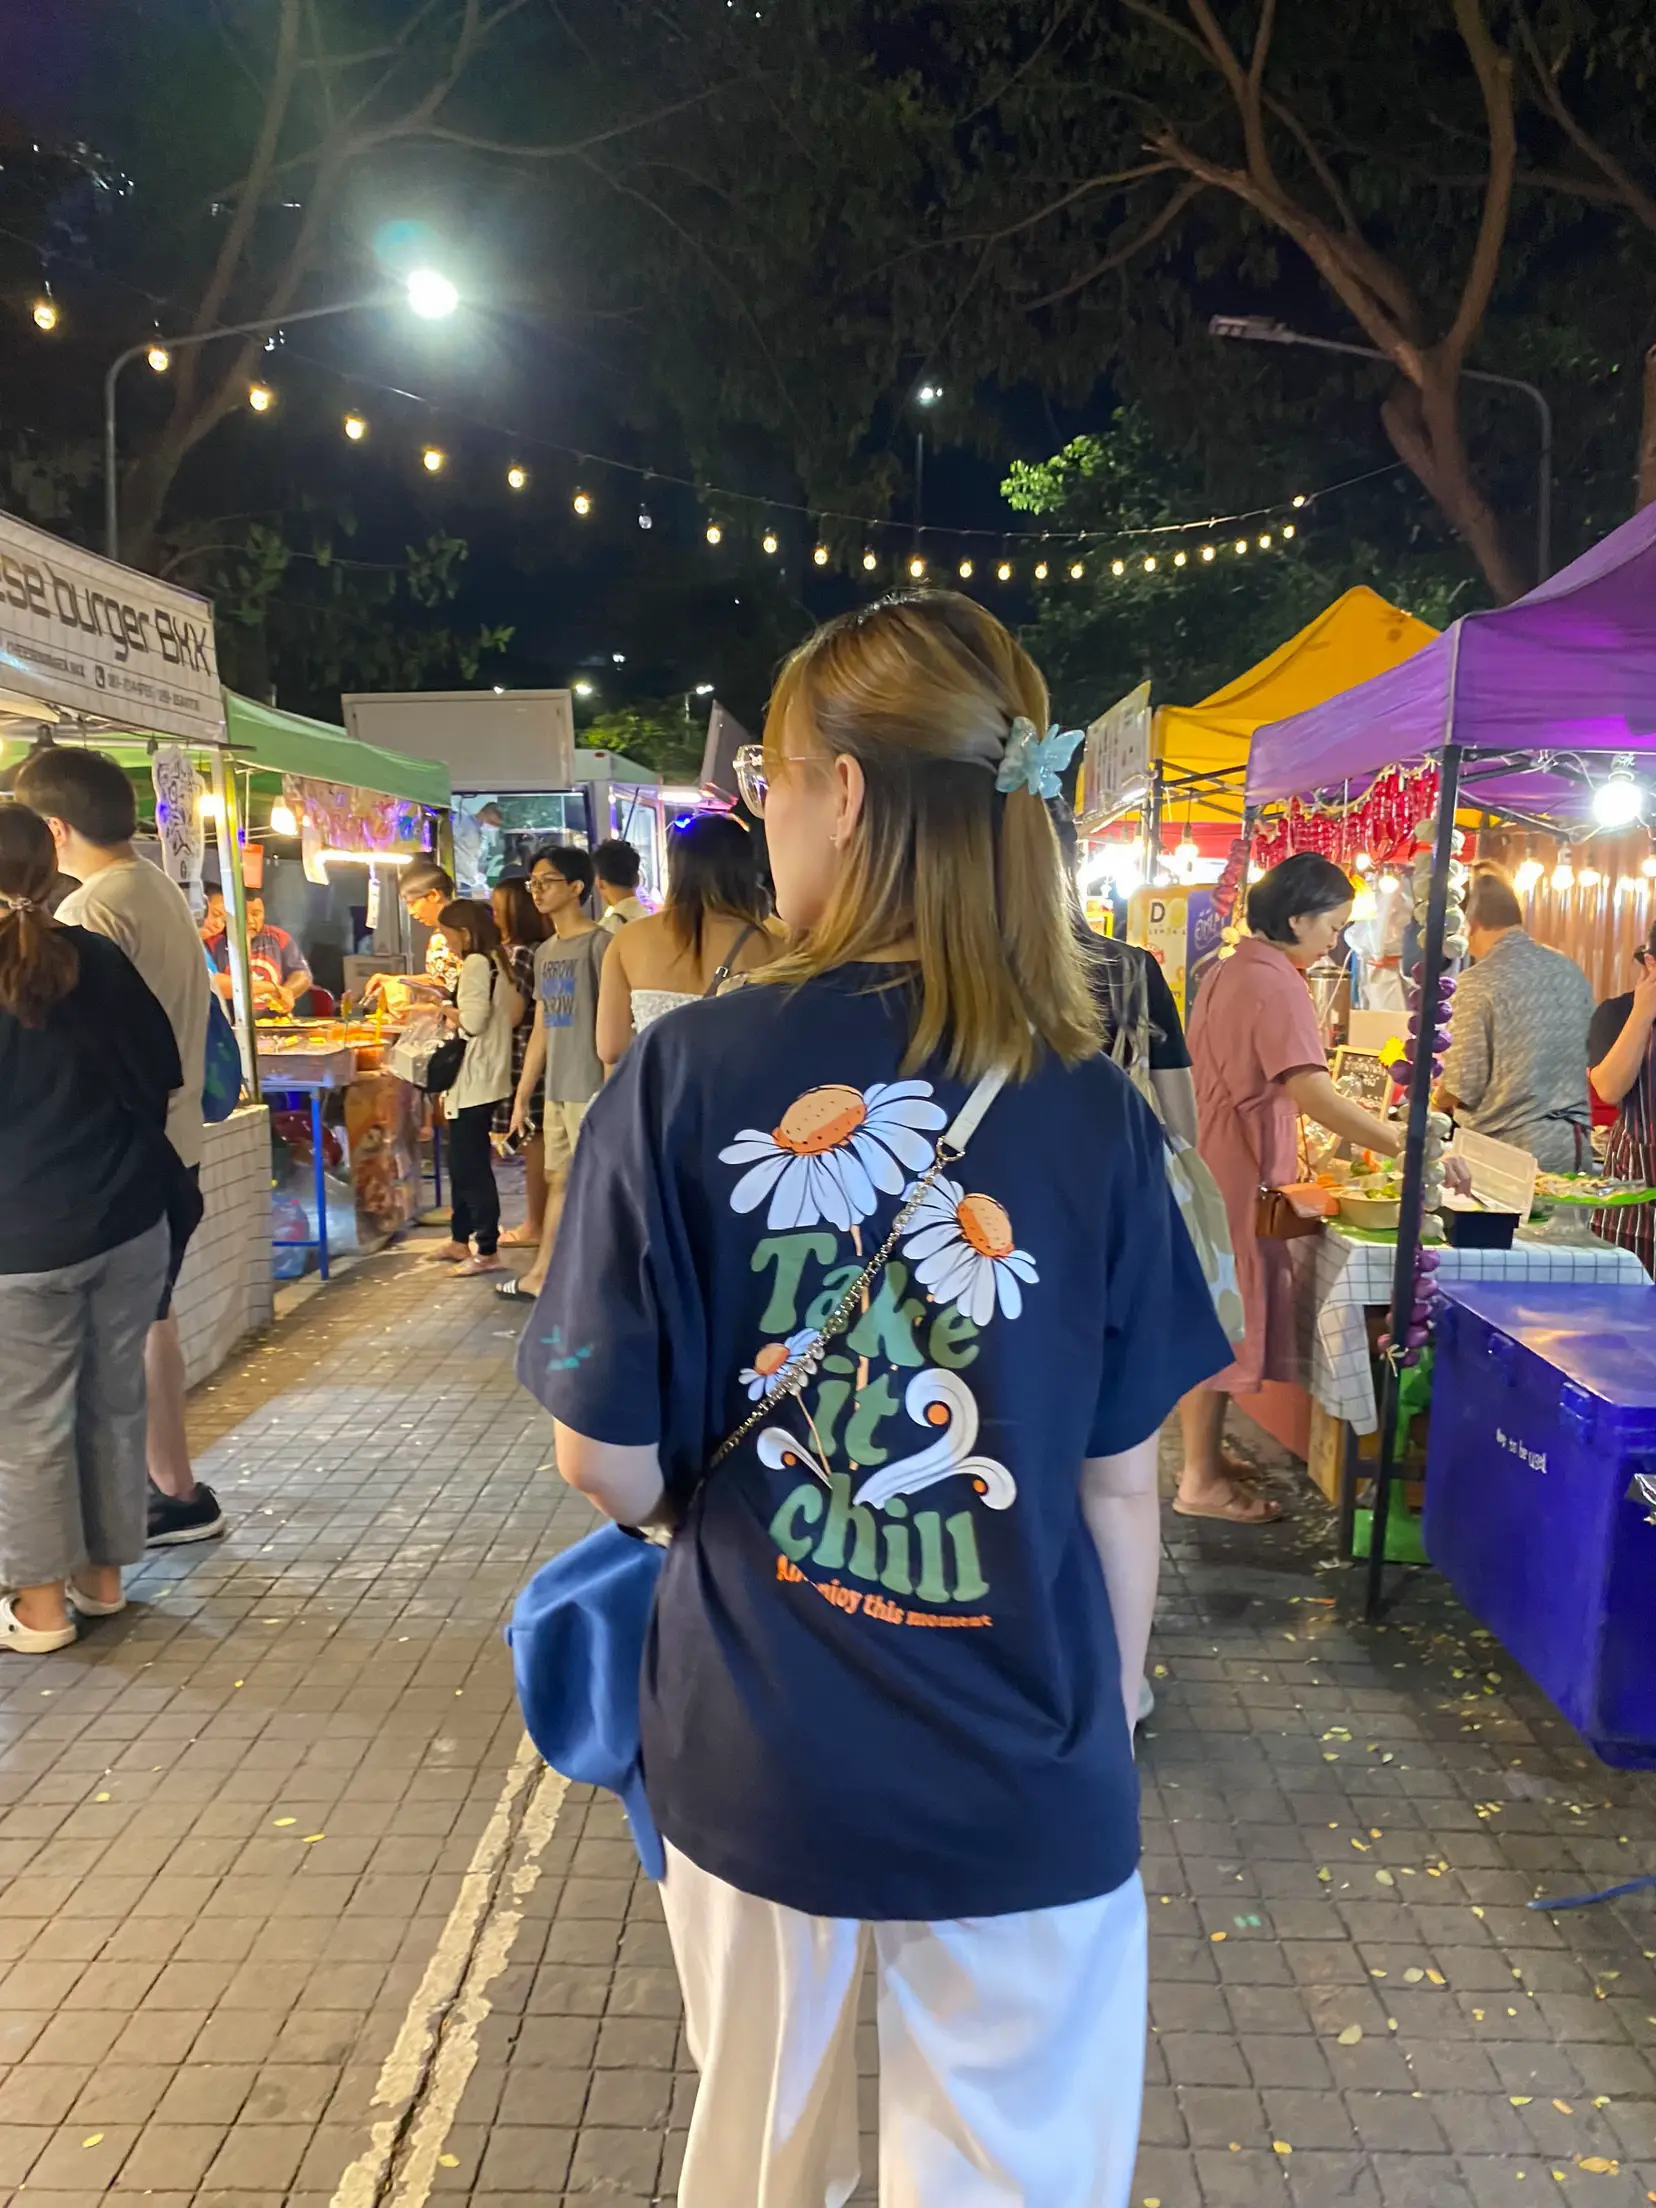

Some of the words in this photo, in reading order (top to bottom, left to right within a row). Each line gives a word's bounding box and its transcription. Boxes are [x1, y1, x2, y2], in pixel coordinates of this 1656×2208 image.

[43, 561, 149, 662] burger
[155, 608, 211, 676] BKK
[542, 959, 578, 978] ARROW
[751, 1231, 982, 1369] Take
[809, 1354, 899, 1467] it
[769, 1473, 990, 1604] chill
[863, 1594, 904, 1625] this
[905, 1610, 993, 1628] moment
